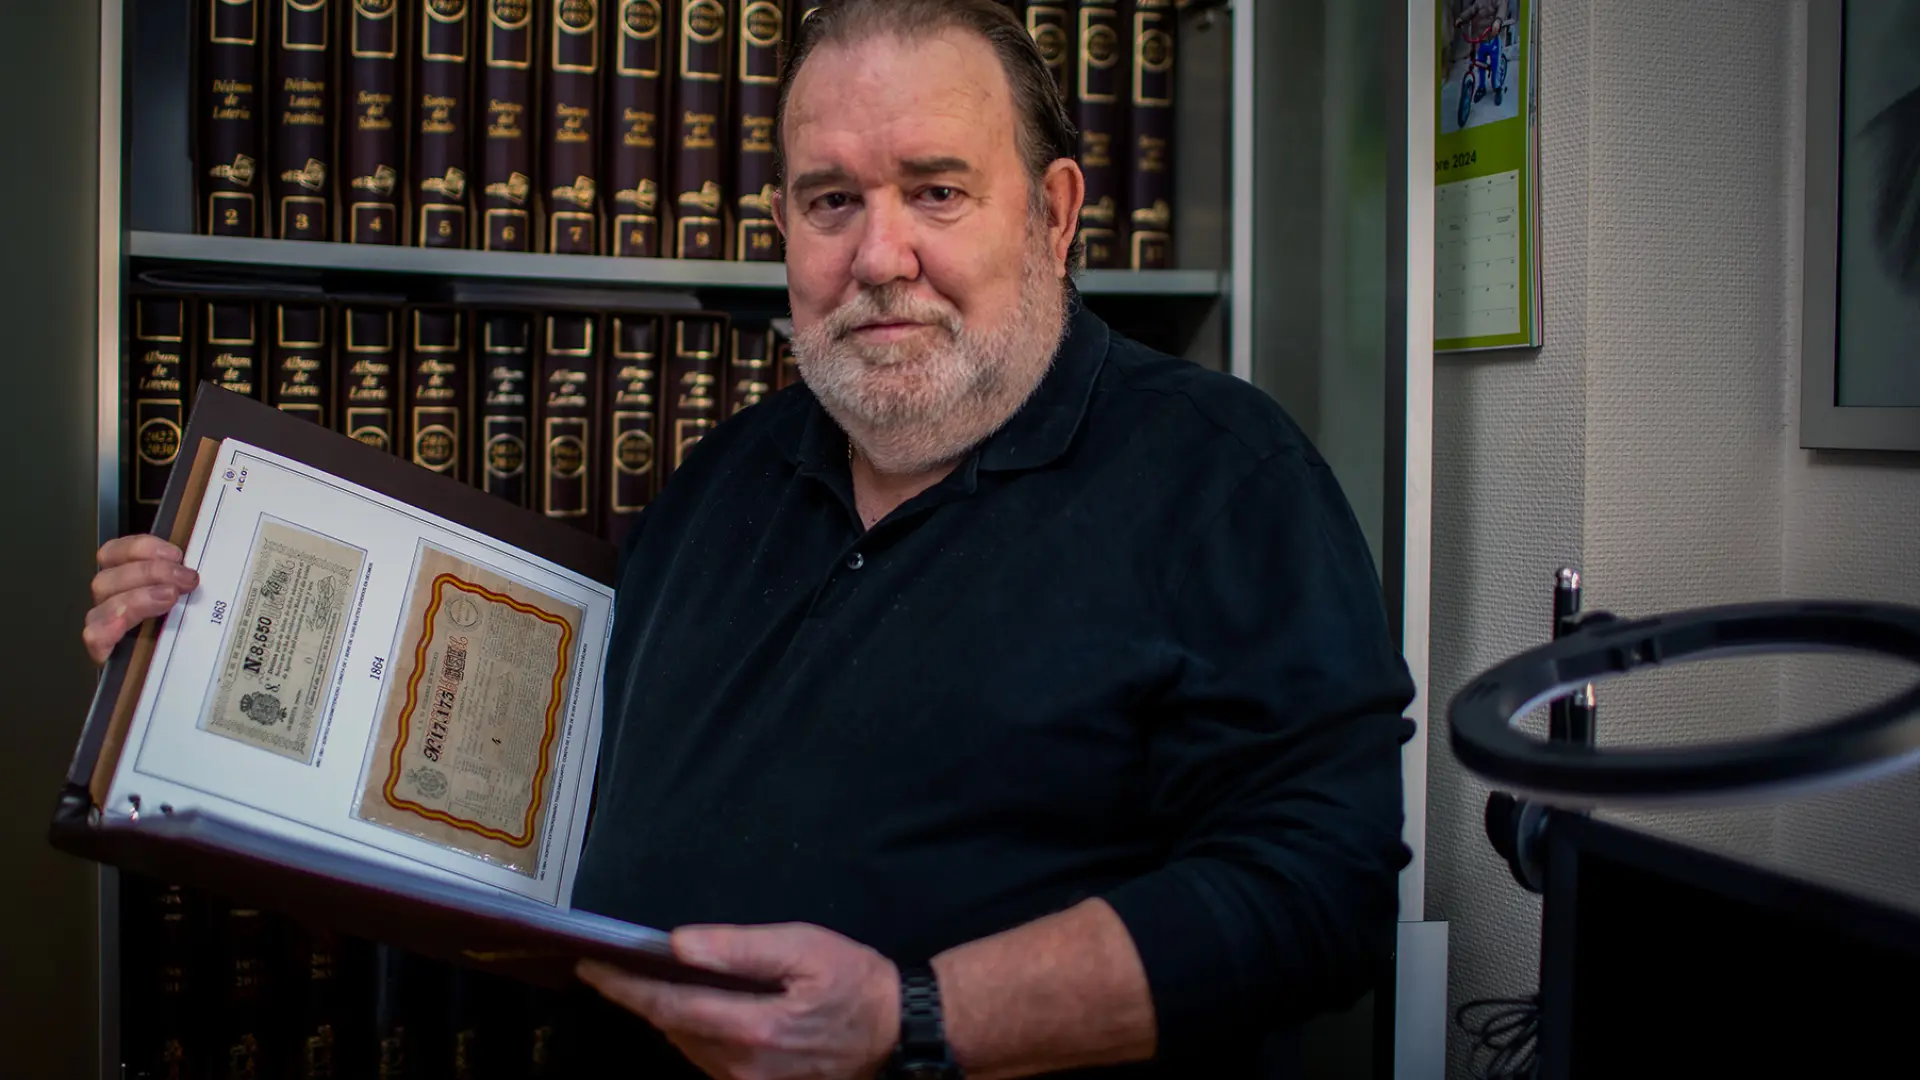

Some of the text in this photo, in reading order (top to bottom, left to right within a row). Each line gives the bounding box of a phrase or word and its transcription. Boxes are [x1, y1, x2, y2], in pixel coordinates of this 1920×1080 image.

[1452, 150, 1476, 169] 2024
[225, 209, 238, 225] 2
[296, 214, 309, 230] 3
[369, 216, 382, 231] 4
[439, 220, 451, 237] 5
[503, 226, 516, 241] 6
[569, 227, 583, 242] 7
[630, 229, 644, 245] 8
[695, 231, 710, 246] 9
[752, 232, 772, 248] 10
[151, 364, 168, 377] de
[223, 367, 240, 380] de
[292, 370, 308, 383] de
[361, 374, 378, 388] de
[428, 373, 444, 386] de
[211, 600, 227, 625] 1863
[243, 616, 272, 674] N.8.650
[369, 656, 385, 681] 1864
